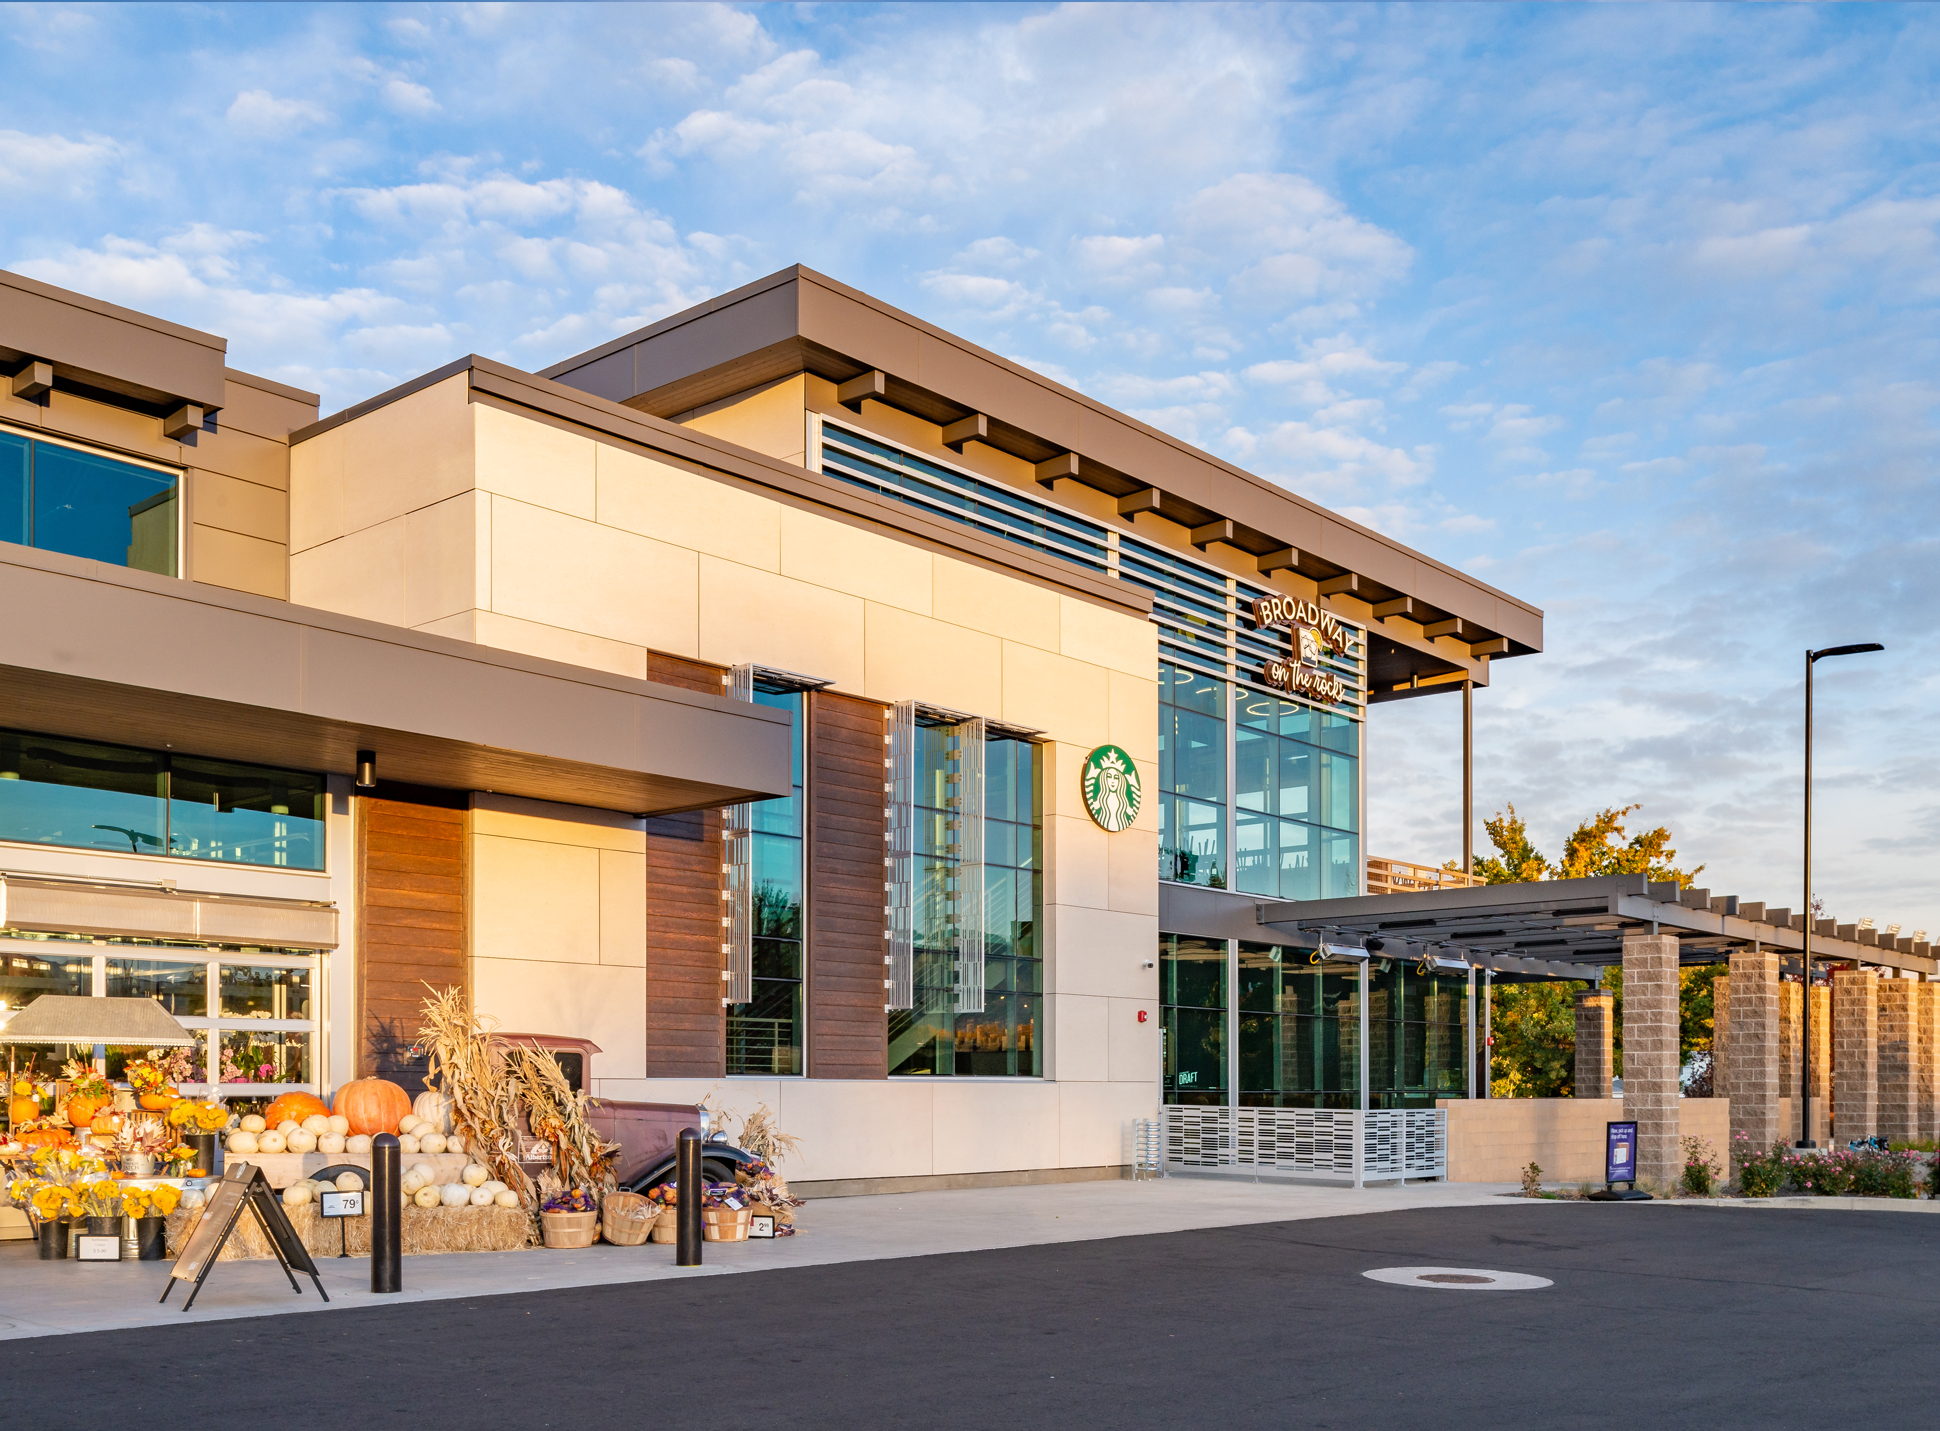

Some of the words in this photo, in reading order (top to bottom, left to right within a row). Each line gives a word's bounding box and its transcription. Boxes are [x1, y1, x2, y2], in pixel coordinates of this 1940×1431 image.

[1260, 597, 1354, 653] BROADWAY
[1272, 664, 1288, 682] on
[1290, 660, 1312, 690] the
[1313, 674, 1345, 702] rocks
[1179, 1071, 1198, 1085] DRAFT
